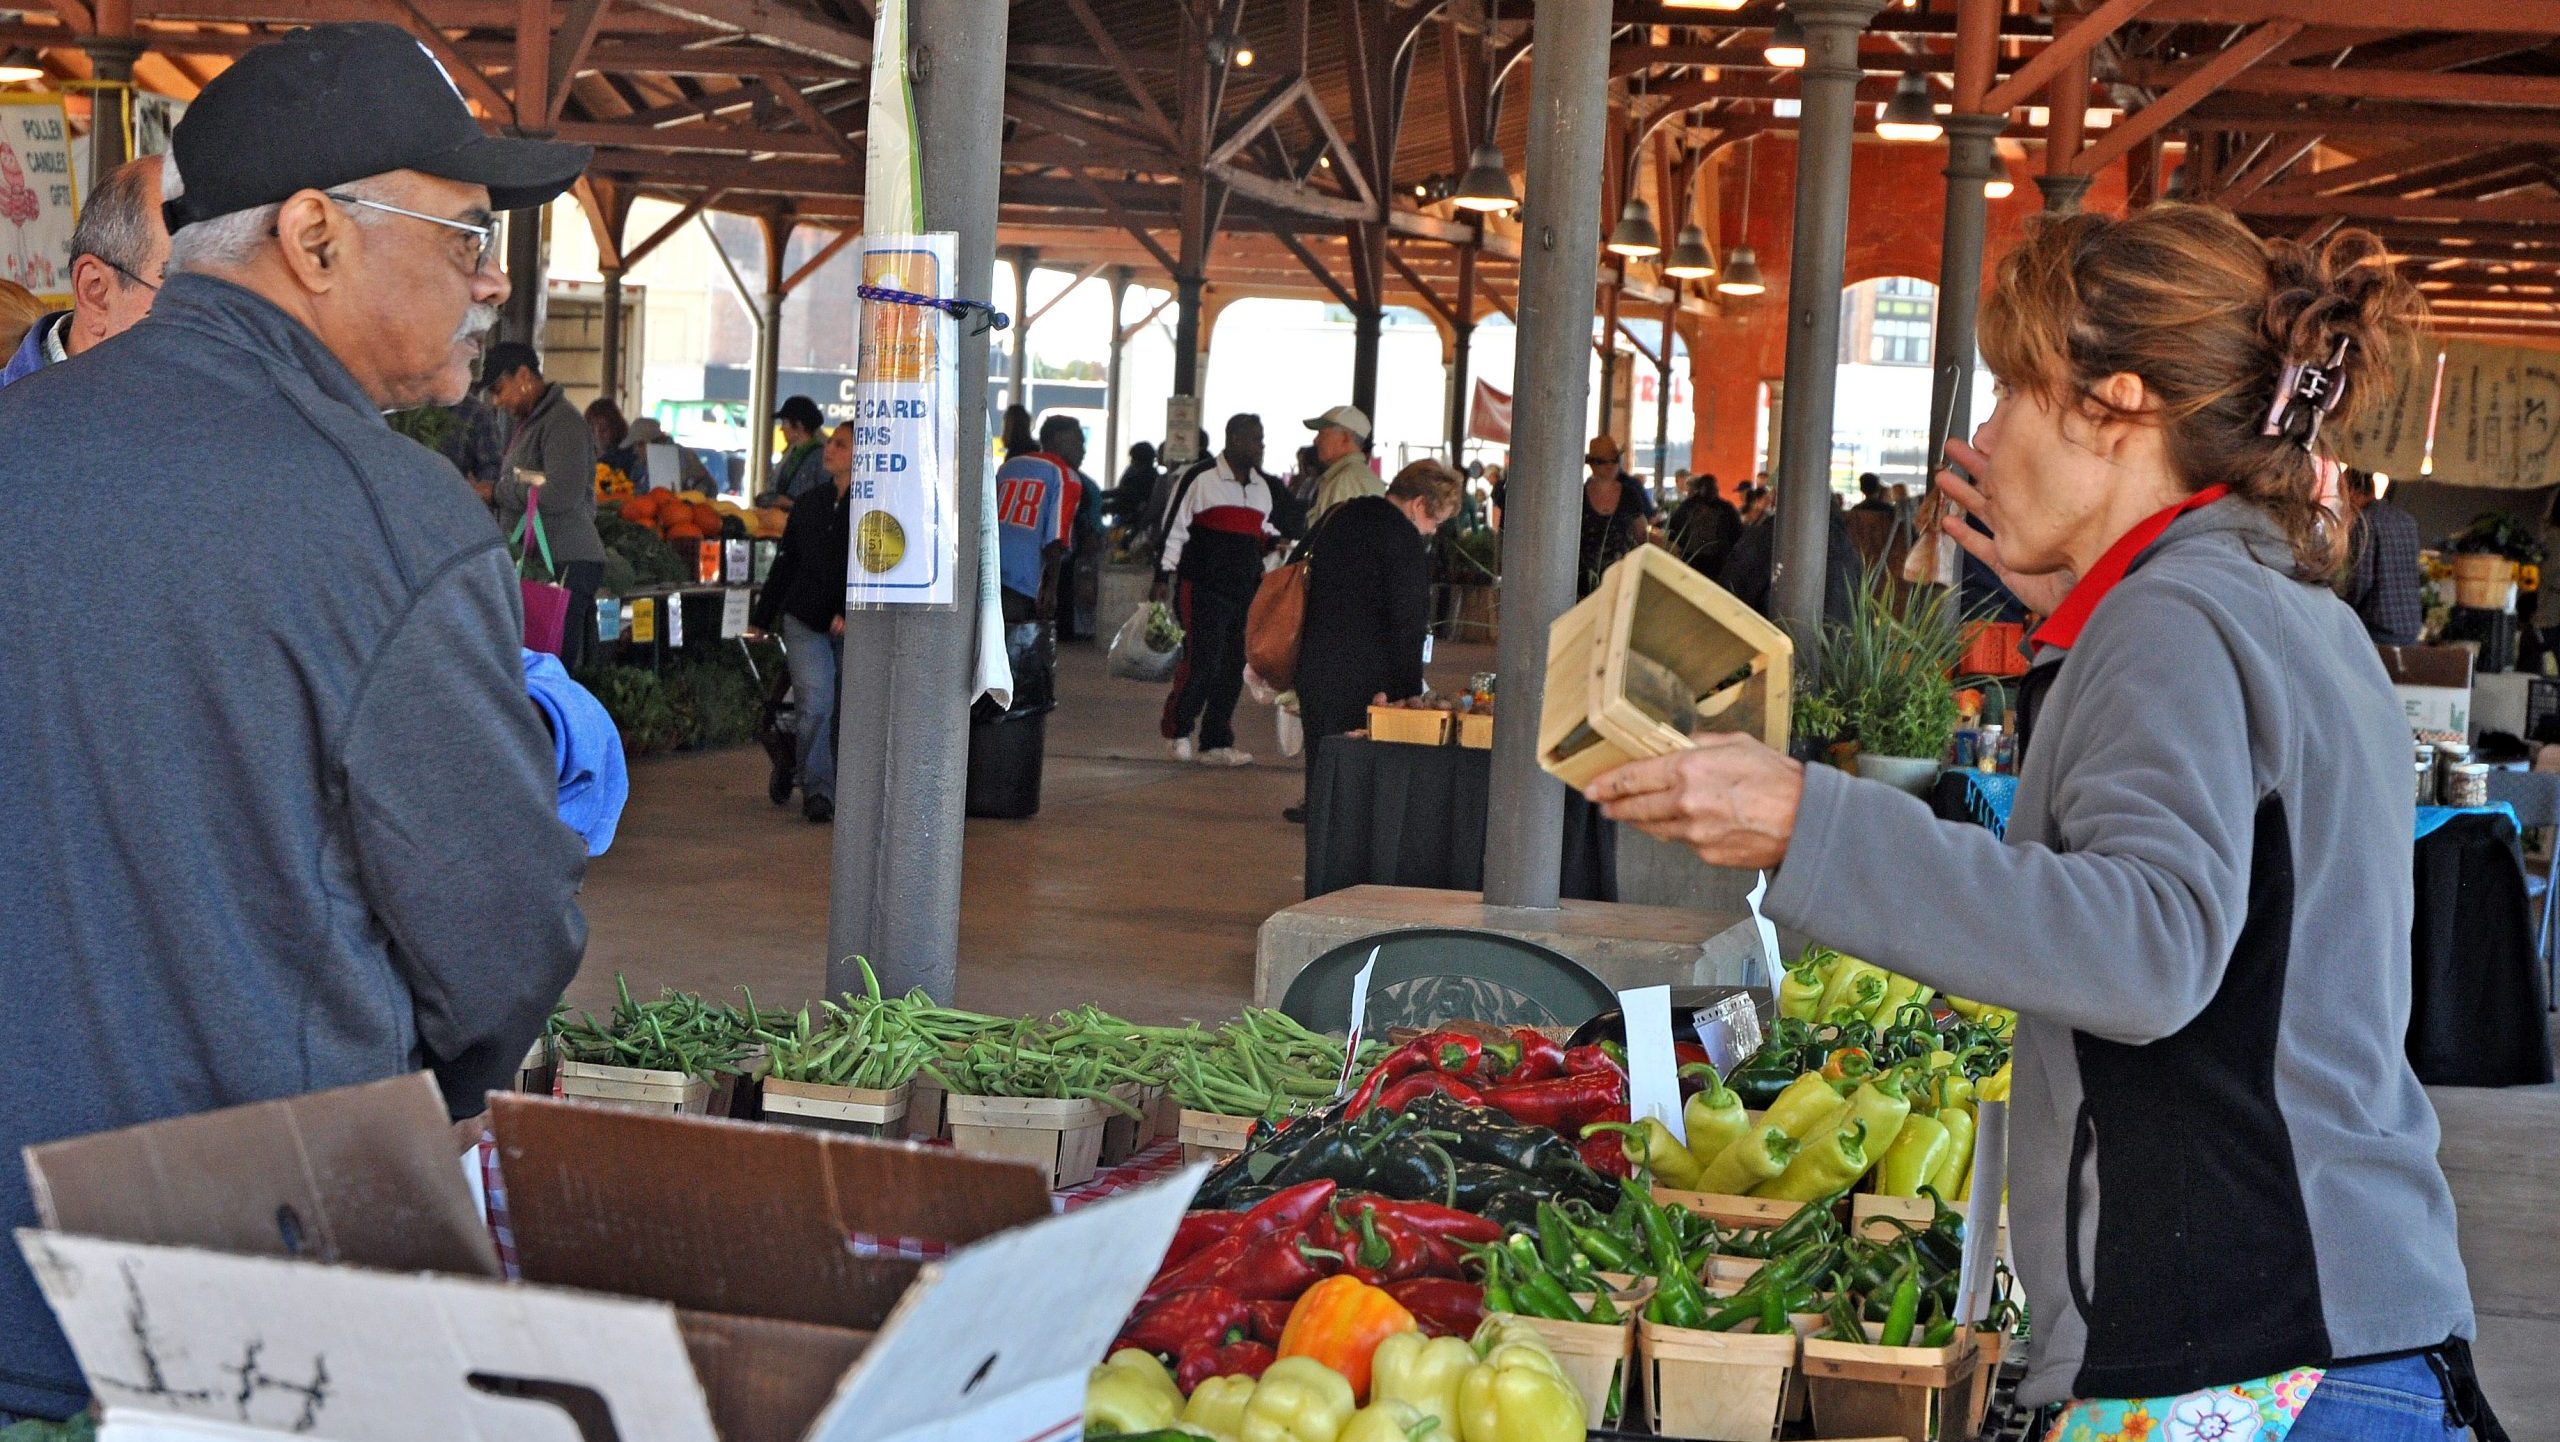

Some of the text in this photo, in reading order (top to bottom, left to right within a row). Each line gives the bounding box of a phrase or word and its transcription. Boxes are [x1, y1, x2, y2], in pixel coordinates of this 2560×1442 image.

[22, 119, 63, 140] POLLEN
[26, 151, 68, 173] CANDLES
[864, 399, 927, 419] CARD
